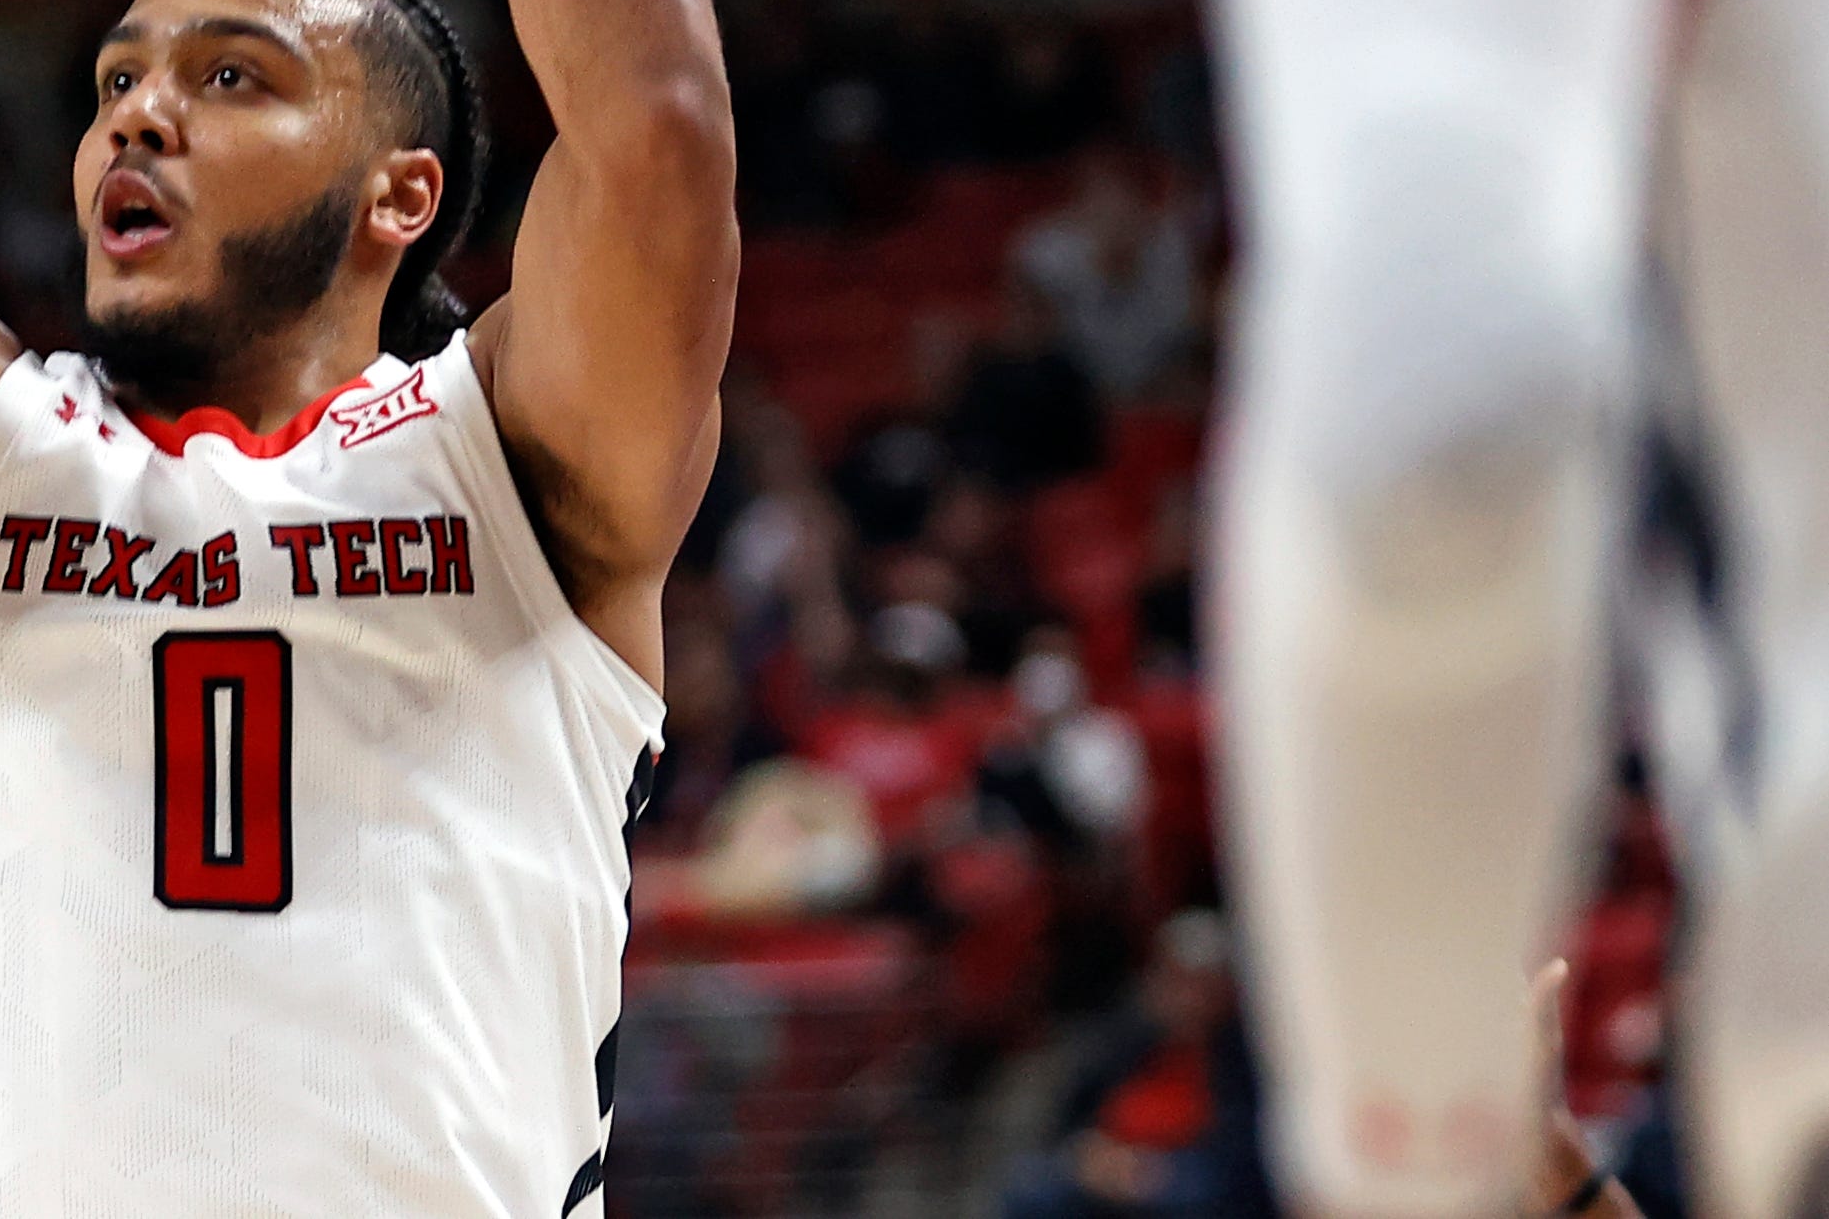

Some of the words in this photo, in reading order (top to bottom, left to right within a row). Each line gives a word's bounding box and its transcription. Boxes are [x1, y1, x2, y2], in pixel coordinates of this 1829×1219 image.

[0, 514, 241, 609] TEXAS
[269, 516, 475, 598] TECH
[152, 629, 293, 913] 0
